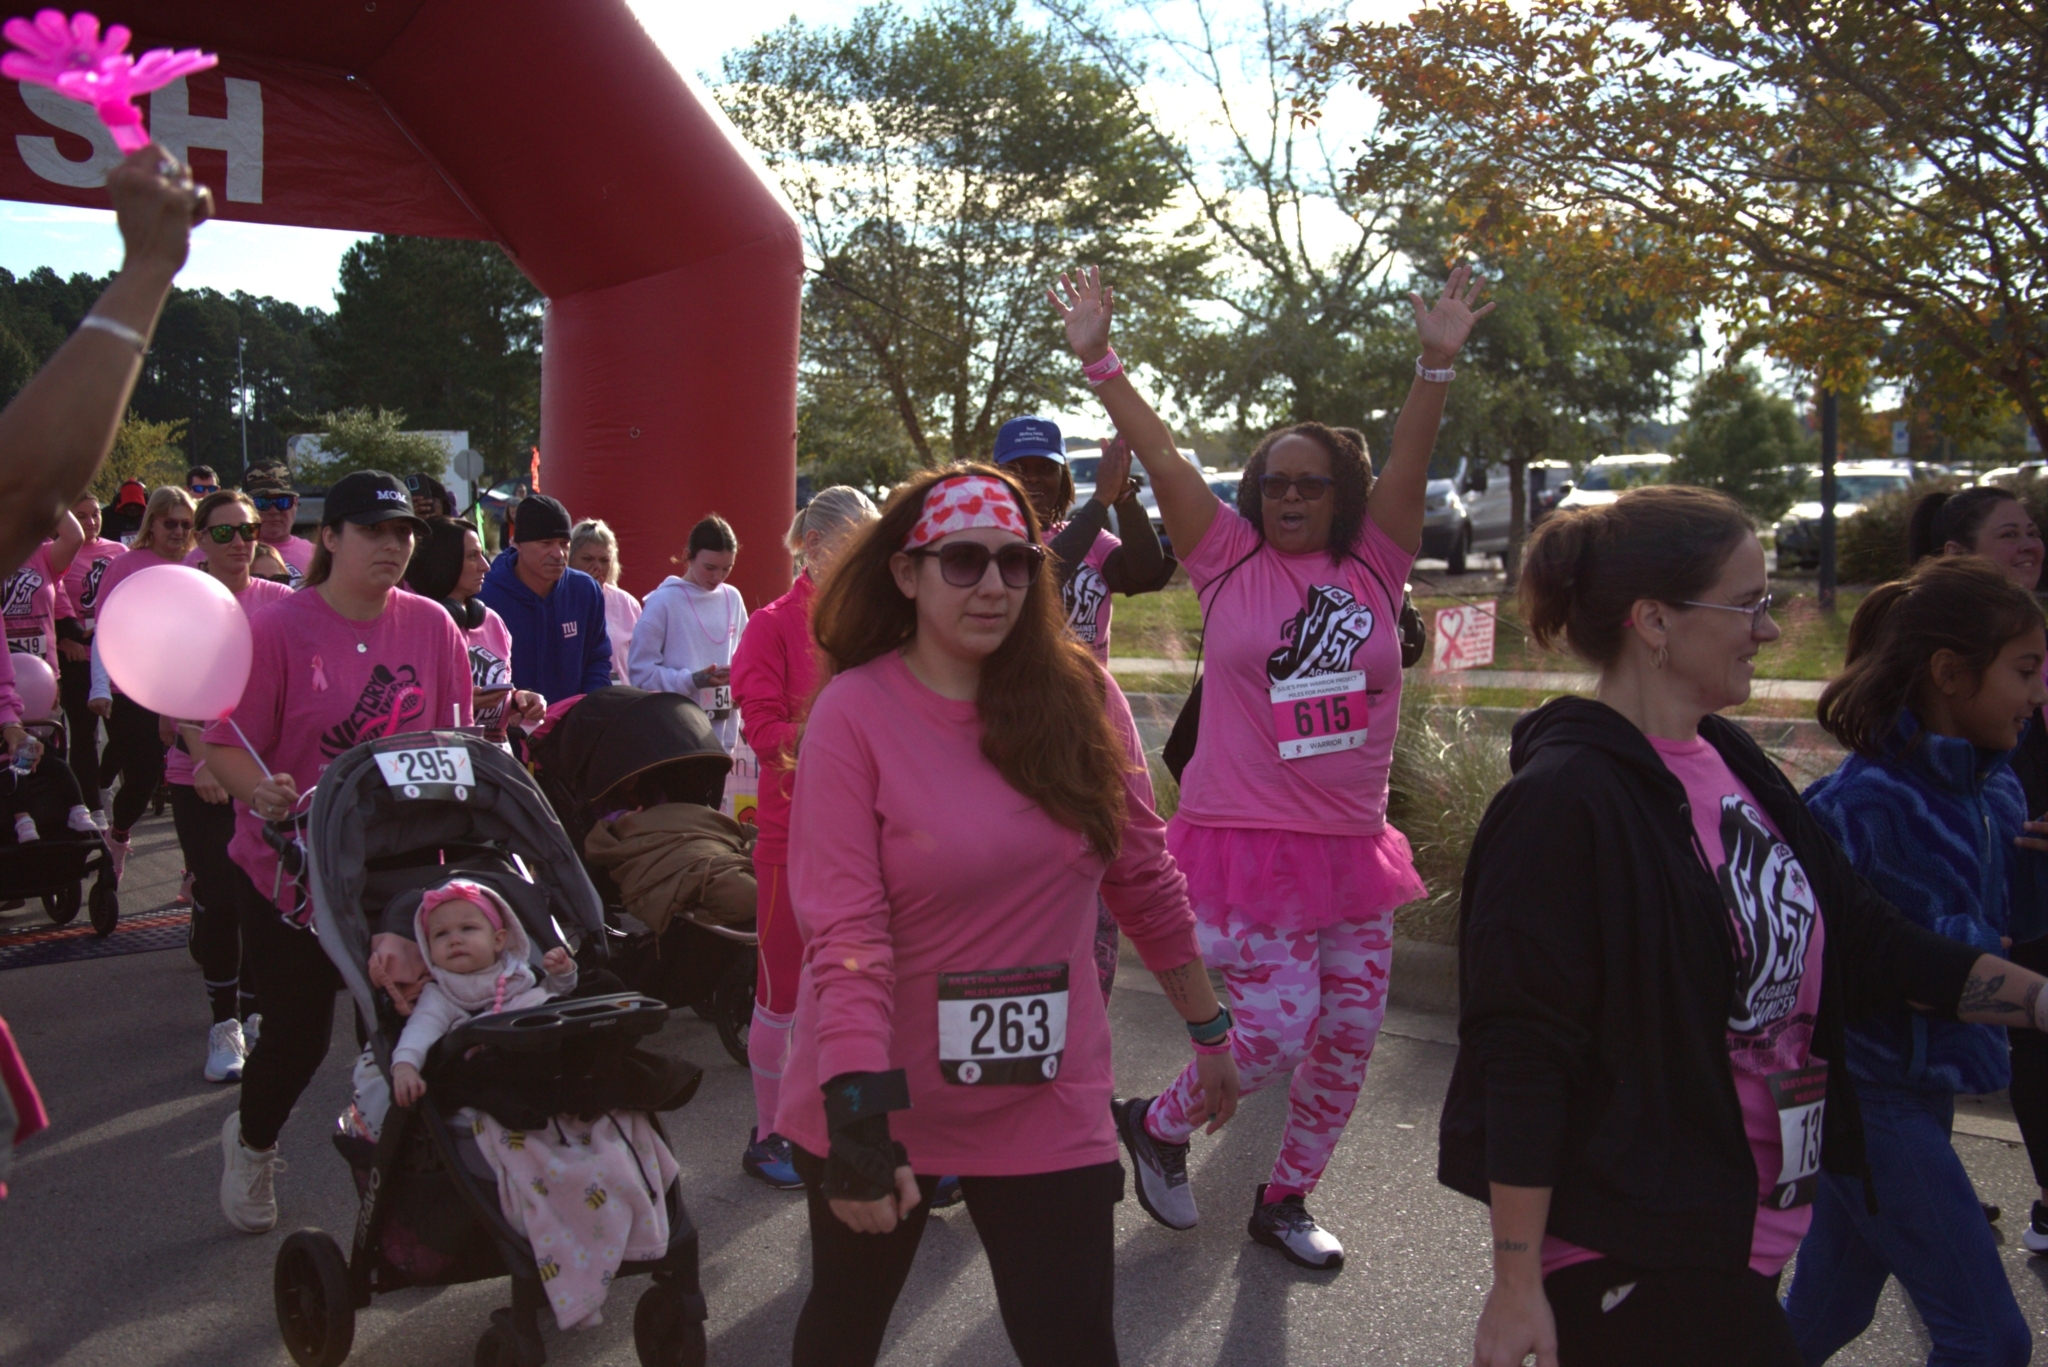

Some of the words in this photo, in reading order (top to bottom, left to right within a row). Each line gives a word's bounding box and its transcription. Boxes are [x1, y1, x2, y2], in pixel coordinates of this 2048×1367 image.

[376, 490, 407, 503] MOM
[16, 583, 36, 604] 5K
[1077, 590, 1102, 624] 5K
[1318, 630, 1359, 671] 5K
[1296, 682, 1309, 690] PINK
[1309, 679, 1335, 687] WARRIOR
[1335, 675, 1357, 684] PROJECT
[320, 674, 386, 751] VICTORY
[1294, 696, 1350, 736] 615
[1310, 739, 1342, 749] WARRIOR
[398, 749, 457, 782] 295
[1774, 902, 1811, 981] 5K
[964, 987, 988, 998] MILES
[990, 986, 1006, 996] FOR
[1007, 984, 1042, 995] MAMMOS
[978, 974, 997, 985] PINK
[998, 972, 1034, 983] WARRIOR
[1034, 969, 1061, 980] PROJECT
[970, 999, 1050, 1055] 263
[1752, 995, 1796, 1028] CANCER
